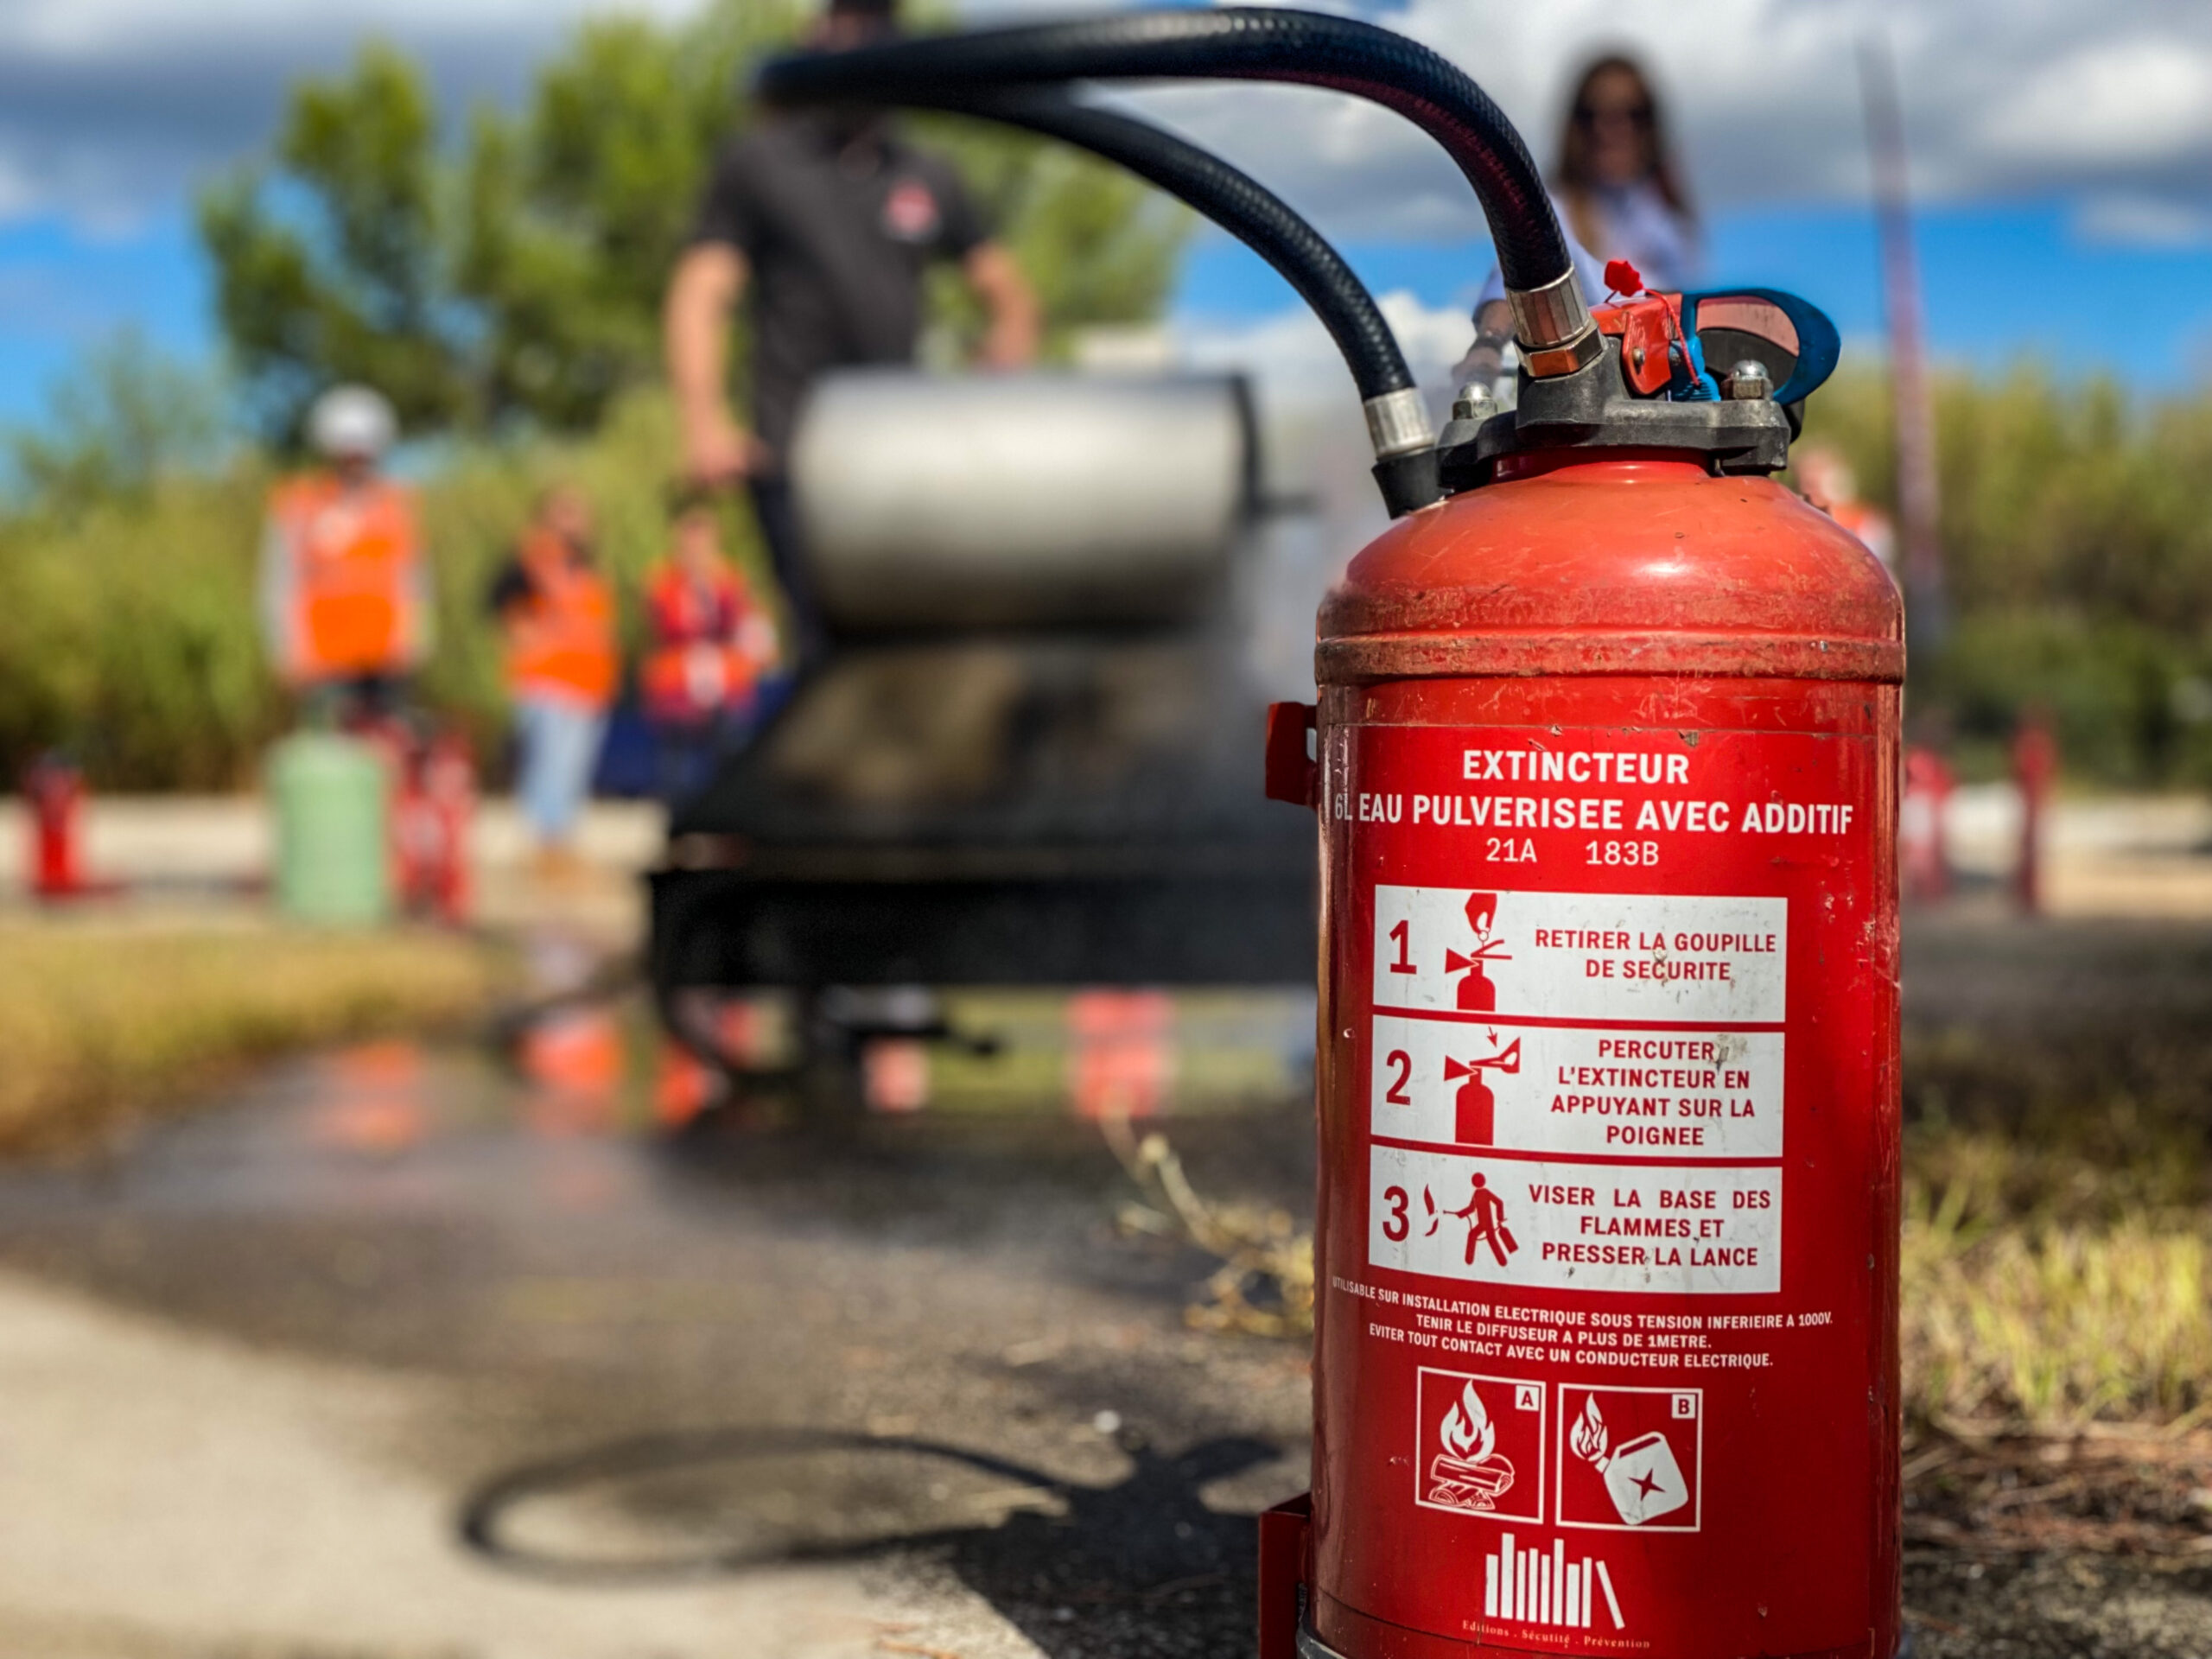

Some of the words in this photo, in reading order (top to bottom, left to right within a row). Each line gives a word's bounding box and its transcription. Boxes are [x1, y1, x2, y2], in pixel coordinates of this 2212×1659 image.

[1463, 749, 1689, 785] EXTINCTEUR
[1335, 793, 1353, 821] 6L
[1359, 792, 1402, 823] EAU
[1413, 794, 1624, 831] PULVERISEE
[1635, 800, 1730, 832] AVEC
[1741, 803, 1853, 836] ADDITIF
[1485, 837, 1537, 863] 21A
[1586, 840, 1660, 866] 183B
[1389, 919, 1417, 975] 1
[1535, 929, 1630, 950] RETIRER
[1640, 931, 1667, 951] LA
[1674, 932, 1777, 953] GOUPILLE
[1586, 958, 1615, 979] DE
[1623, 960, 1731, 981] SECURITE
[1599, 1039, 1714, 1060] PERCUTER
[1386, 1049, 1413, 1107] 2
[1559, 1066, 1715, 1089] L'EXTINCTEUR
[1725, 1070, 1750, 1090] EN
[1550, 1095, 1669, 1118] APPUYANT
[1678, 1098, 1723, 1118] SUR
[1731, 1099, 1755, 1118] LA
[1606, 1125, 1704, 1147] POIGNEE
[1529, 1185, 1596, 1207] VISER
[1613, 1188, 1643, 1208] LA
[1659, 1189, 1717, 1210] BASE
[1732, 1189, 1771, 1211] DES
[1382, 1185, 1410, 1243] 3
[1580, 1216, 1691, 1239] FLAMMES
[1700, 1219, 1725, 1238] ET
[1541, 1243, 1644, 1266] PRESSER
[1655, 1247, 1681, 1267] LA
[1690, 1248, 1758, 1268] LANCE
[1332, 1275, 1376, 1300] UTILISABLE
[1378, 1288, 1399, 1305] SUR
[1402, 1293, 1490, 1318] INSTALLATION
[1495, 1305, 1586, 1326] ELECTRIQUE
[1591, 1313, 1632, 1328] SOUS
[1637, 1315, 1702, 1330] TENSION
[1707, 1314, 1783, 1330] INFERIEIRE
[1786, 1313, 1795, 1327] A
[1416, 1313, 1452, 1332] TENIR
[1457, 1320, 1472, 1334] LE
[1477, 1323, 1558, 1343] DIFFUSEUR
[1562, 1330, 1573, 1344] A
[1578, 1332, 1618, 1347] PLUS
[1623, 1333, 1643, 1348] DE
[1648, 1334, 1712, 1349] 1METRE.
[1370, 1323, 1404, 1342] EVITER
[1408, 1331, 1438, 1348] TOUT
[1441, 1337, 1503, 1357] CONTACT
[1506, 1344, 1544, 1361] AVEC
[1549, 1348, 1570, 1363] UN
[1575, 1350, 1679, 1368] CONDUCTEUR
[1684, 1353, 1774, 1370] ELECTRIQUE.
[1521, 1390, 1534, 1408] A
[1677, 1399, 1690, 1414] B
[1583, 1634, 1651, 1649] Prévention
